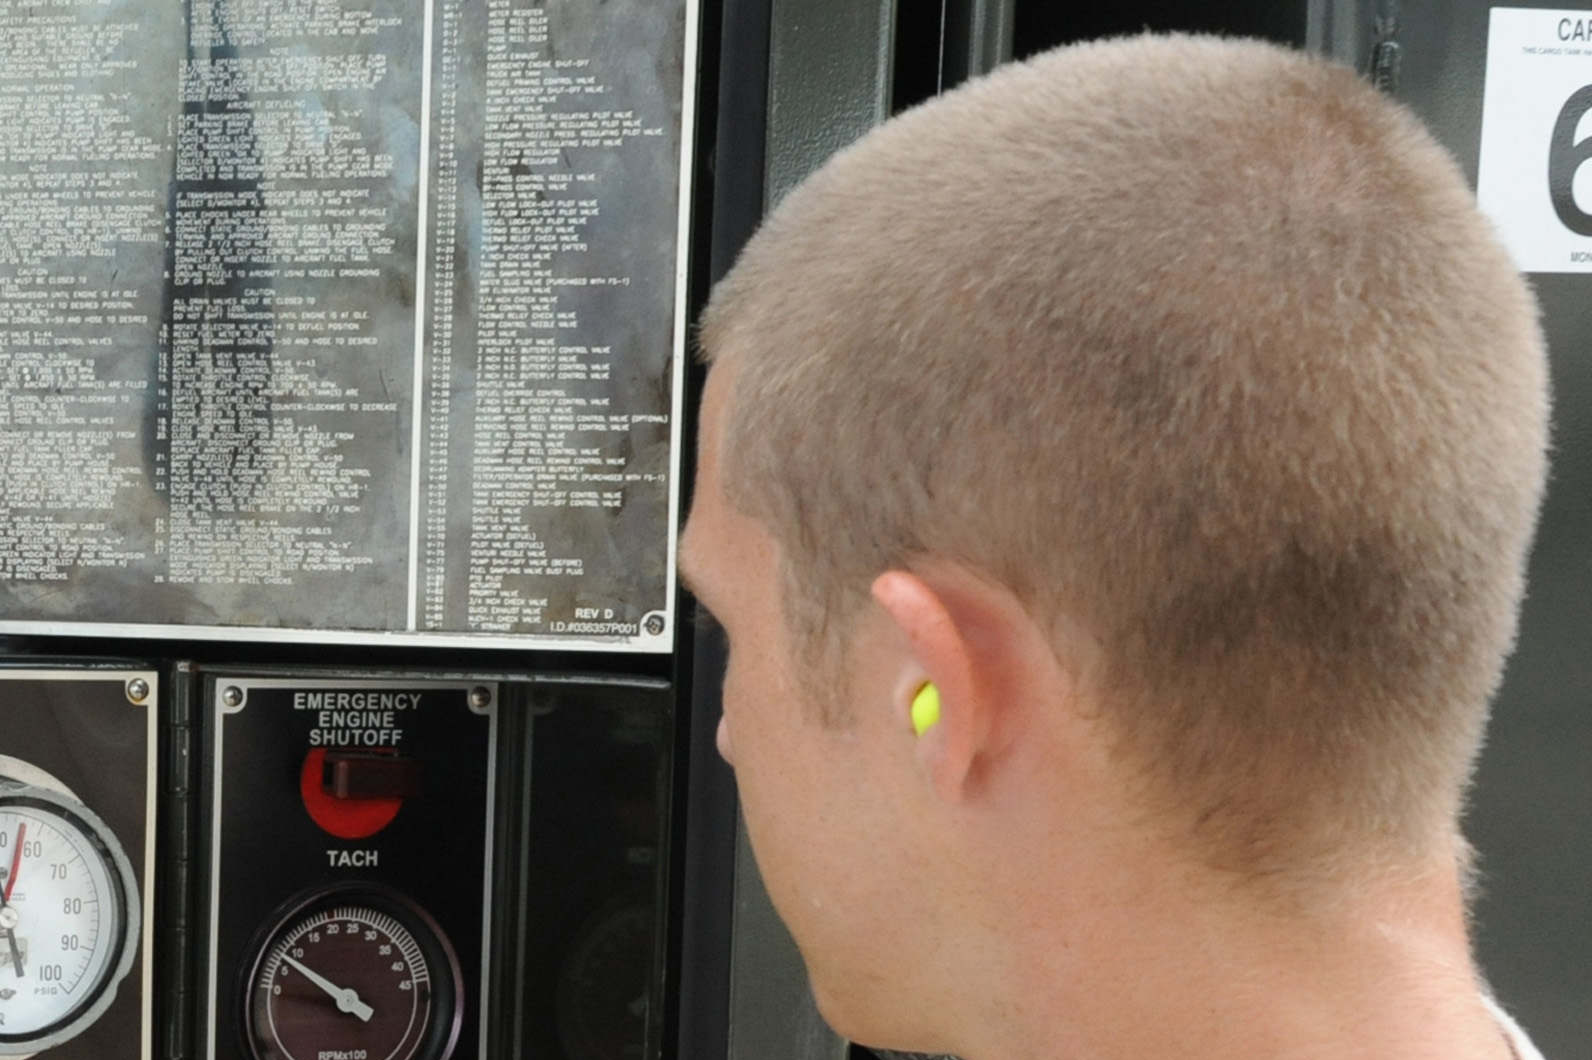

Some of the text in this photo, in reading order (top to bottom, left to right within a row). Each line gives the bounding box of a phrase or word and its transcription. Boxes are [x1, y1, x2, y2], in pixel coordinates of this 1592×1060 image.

[575, 608, 613, 619] REV D
[294, 693, 420, 709] EMERGENCY
[319, 711, 393, 727] ENGINE
[310, 729, 402, 745] SHUTOFF
[24, 841, 42, 858] 60
[327, 851, 377, 866] TACH
[50, 864, 67, 879] 70
[64, 898, 81, 914] 80
[327, 924, 339, 934] 20
[347, 923, 359, 933] 25
[308, 933, 320, 943] 15
[365, 931, 377, 940] 30
[62, 935, 78, 951] 90
[291, 948, 304, 958] 10
[379, 945, 391, 955] 35
[281, 966, 288, 976] 5
[391, 961, 404, 972] 40
[40, 965, 62, 981] 100
[274, 985, 281, 995] 0
[399, 980, 411, 990] 45
[319, 1050, 366, 1060] RPMx100
